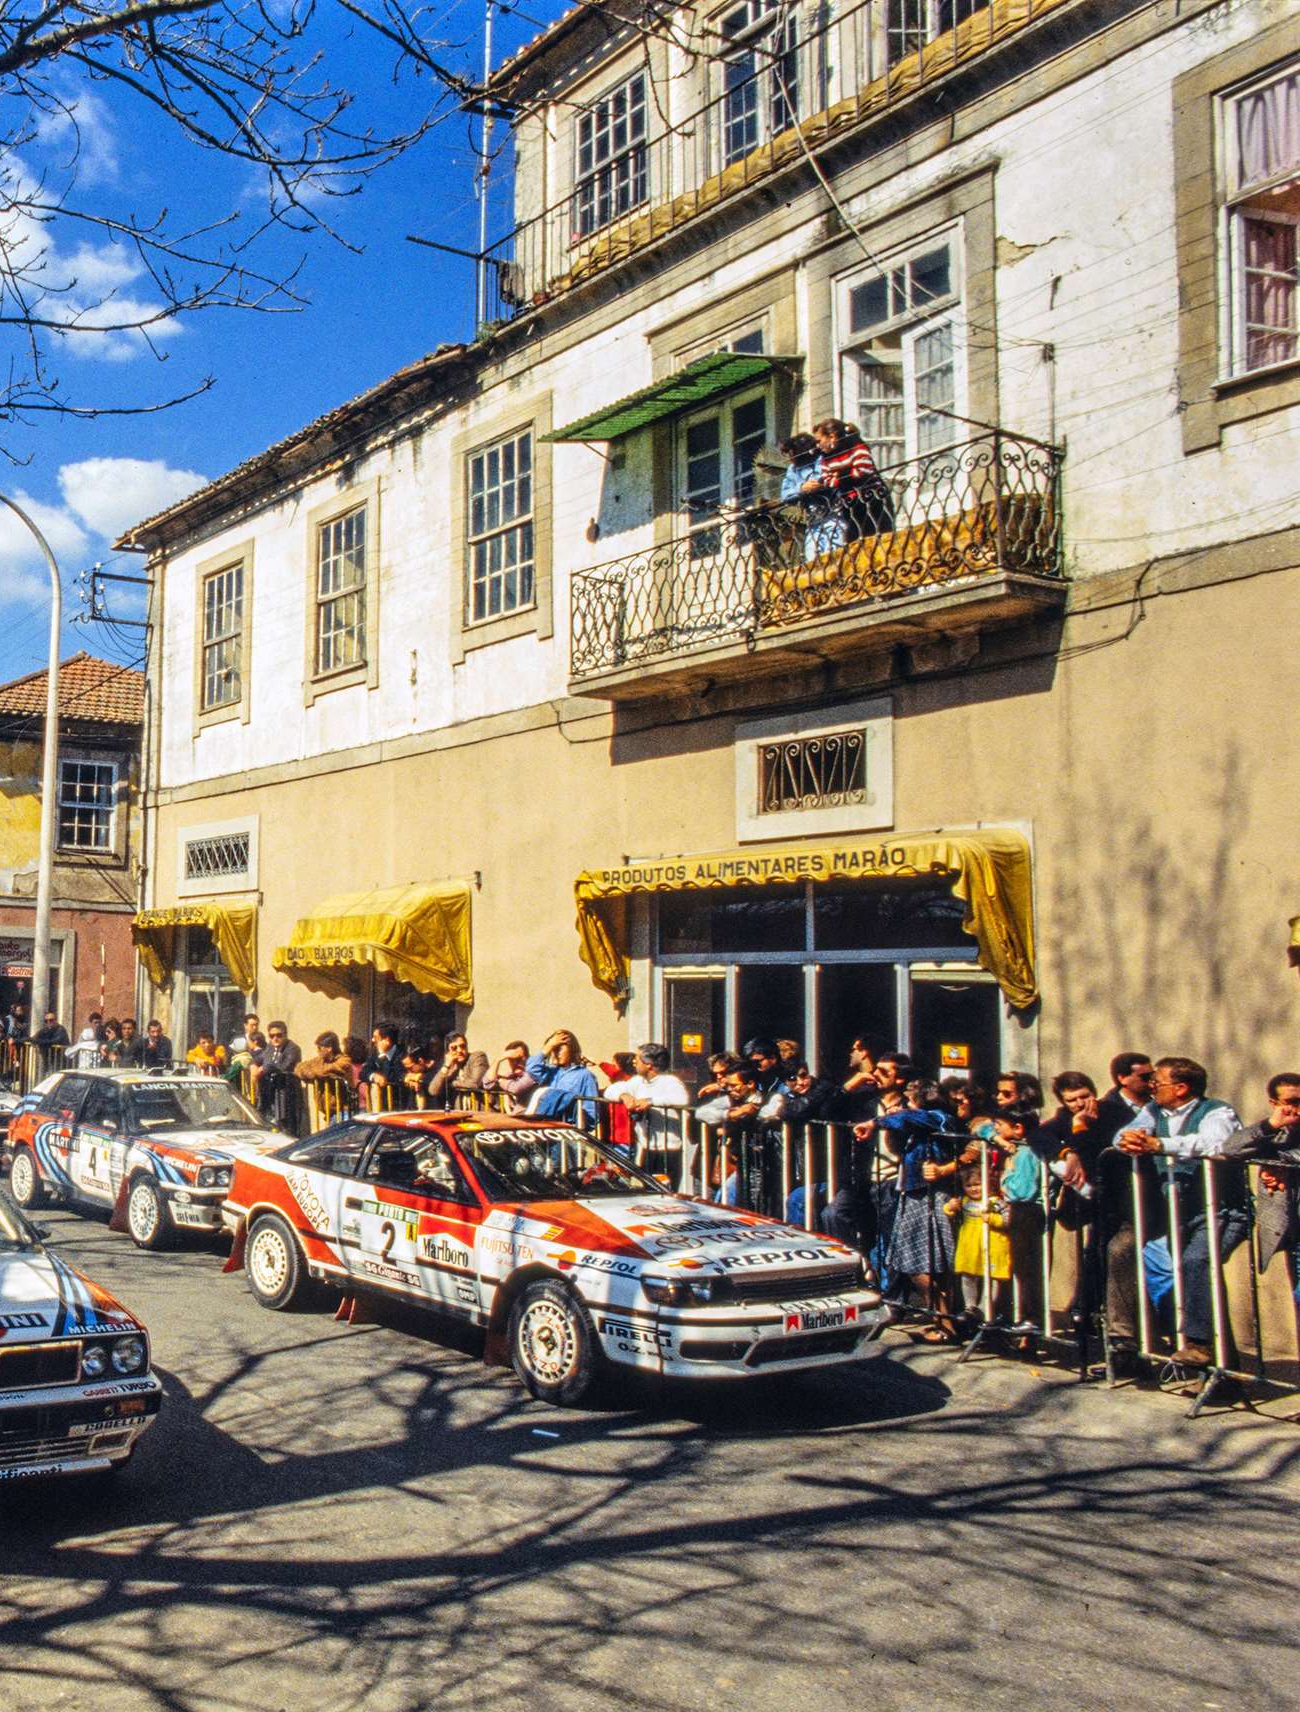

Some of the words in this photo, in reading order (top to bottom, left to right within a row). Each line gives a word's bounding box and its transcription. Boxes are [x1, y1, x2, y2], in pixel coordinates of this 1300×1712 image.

[602, 866, 686, 886] PRODUTOS
[695, 855, 824, 879] ALIMENTARES
[832, 847, 906, 870] MARÃO
[314, 945, 355, 960] BARROS
[132, 1083, 178, 1091] LANCIA
[500, 1128, 588, 1143] TOYOTA
[88, 1146, 97, 1177] 4
[380, 1220, 397, 1265] 2
[697, 1230, 801, 1244] TOYOTA
[423, 1236, 469, 1268] Marlboro
[481, 1236, 515, 1256] FUJITSU
[518, 1244, 533, 1260] TEN
[718, 1247, 836, 1269] REPSOL
[580, 1254, 637, 1274] REPSOL
[68, 1324, 136, 1335] MICHELIN
[801, 1310, 844, 1330] Marlboro
[598, 1316, 672, 1347] PIRELLI
[118, 1381, 155, 1392] TURBO
